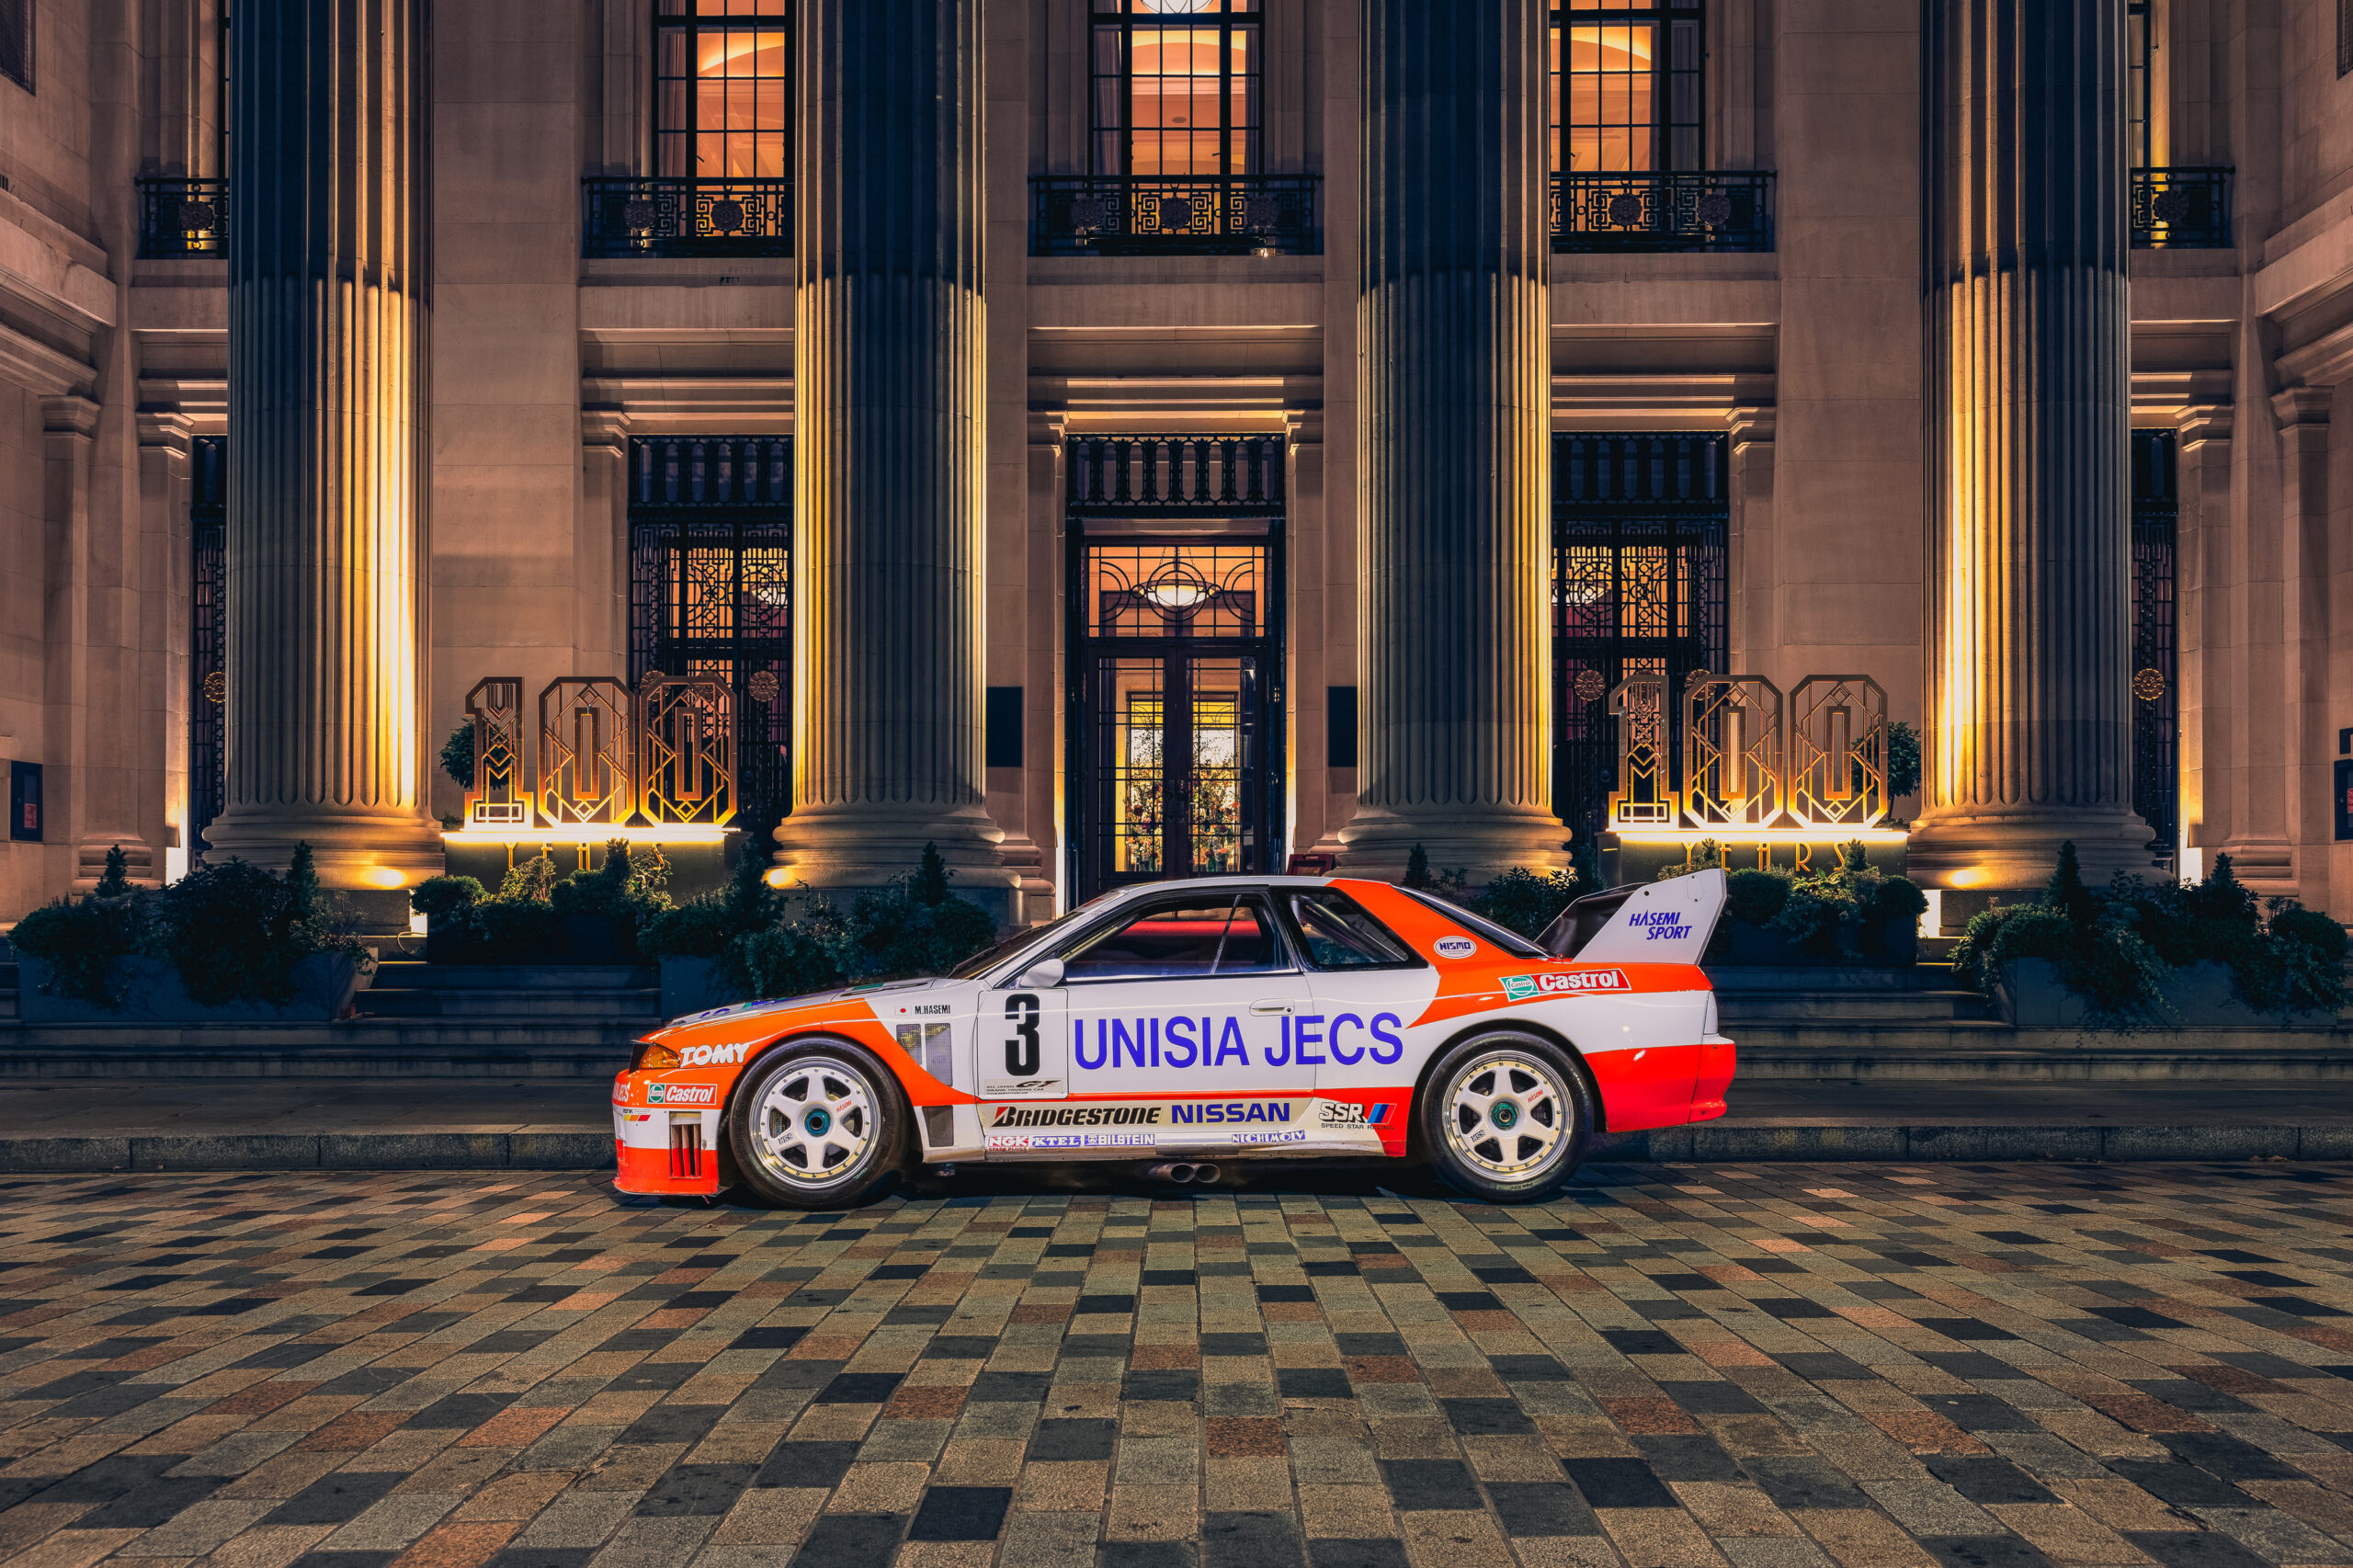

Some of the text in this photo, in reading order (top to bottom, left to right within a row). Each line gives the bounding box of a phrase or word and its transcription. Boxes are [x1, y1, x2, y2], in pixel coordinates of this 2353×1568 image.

[465, 676, 736, 828] 100
[1608, 674, 1888, 828] 100
[1681, 840, 1846, 872] YEARS
[1629, 909, 1681, 926] HASEMI
[1646, 926, 1692, 940] SPORT
[1540, 971, 1619, 991] Castrol
[915, 1005, 950, 1015] M.HASEMI
[1005, 993, 1040, 1076] 3
[1074, 1012, 1404, 1070] UNISIA JECS
[680, 1043, 750, 1067] TOMY
[666, 1085, 713, 1102] Castrol
[991, 1107, 1162, 1128] BRIDGESTONE
[1171, 1103, 1290, 1123] NISSAN
[1318, 1102, 1366, 1123] SSR
[989, 1136, 1029, 1147] NGK
[1097, 1135, 1154, 1145] BILSTEIN
[1232, 1131, 1305, 1143] NICHIMOLY
